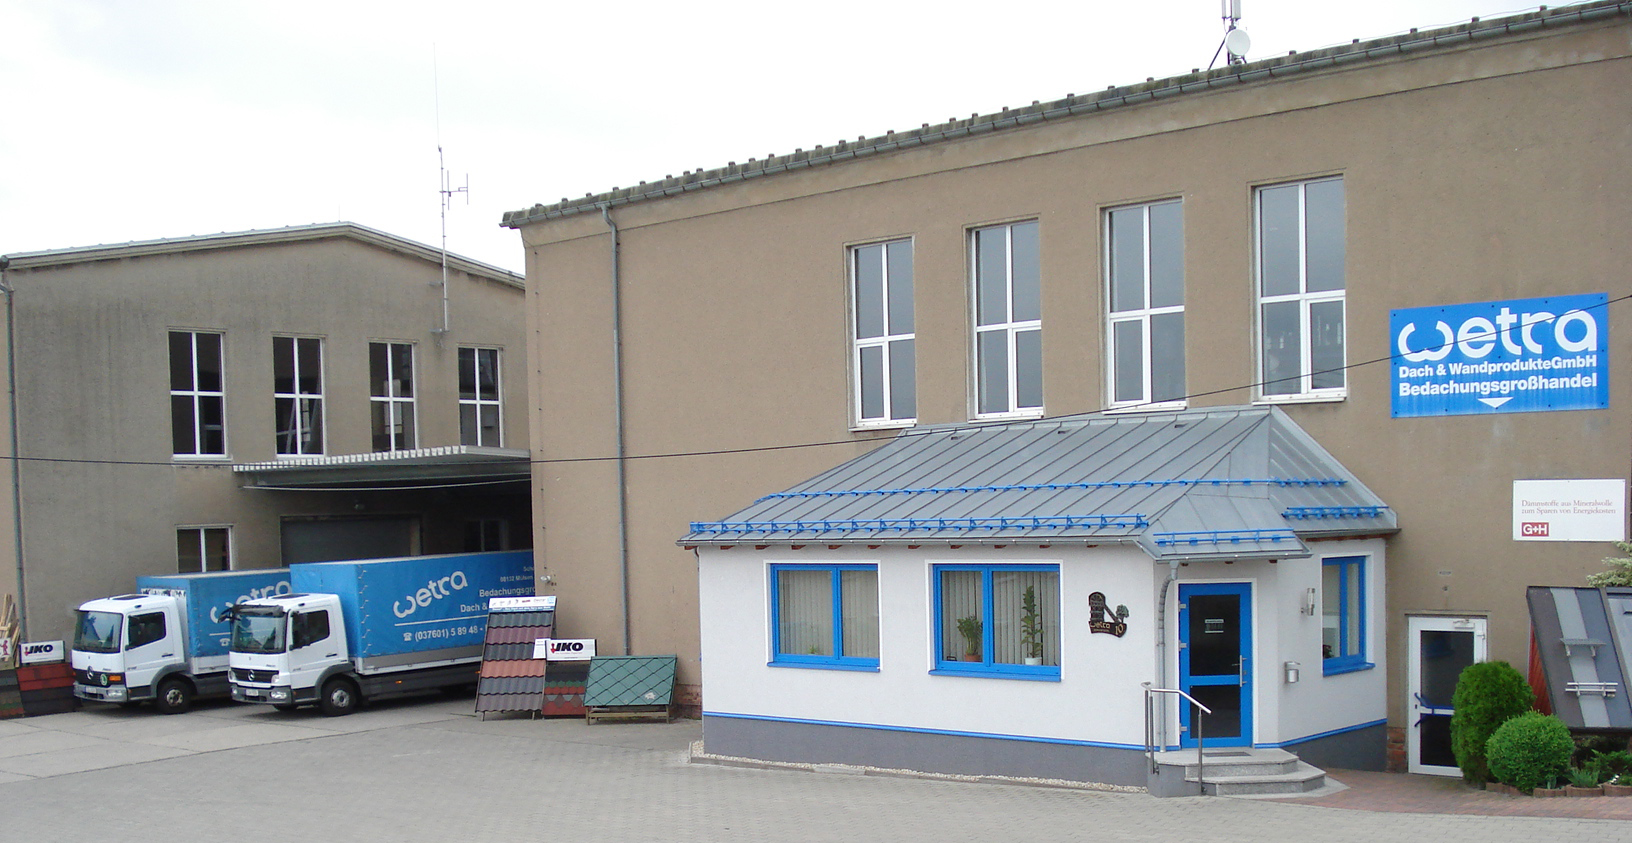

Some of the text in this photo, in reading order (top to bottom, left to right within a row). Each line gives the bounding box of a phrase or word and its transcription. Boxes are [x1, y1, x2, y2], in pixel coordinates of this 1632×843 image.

[1397, 307, 1597, 362] wetra
[1399, 355, 1597, 378] Dach & WandprodukteGmbH
[1399, 373, 1597, 397] Bedachungsgroßhandel
[1536, 507, 1558, 515] Sparen
[1573, 507, 1616, 515] Energiekosten
[1573, 499, 1613, 507] Mineralwolle
[1523, 524, 1548, 535] G+H
[393, 571, 468, 618] wetra
[460, 603, 480, 613] Dach
[481, 602, 488, 611] &
[414, 628, 449, 642] (037601)
[450, 627, 456, 636] 5
[457, 626, 467, 636] 89
[468, 625, 478, 634] 48
